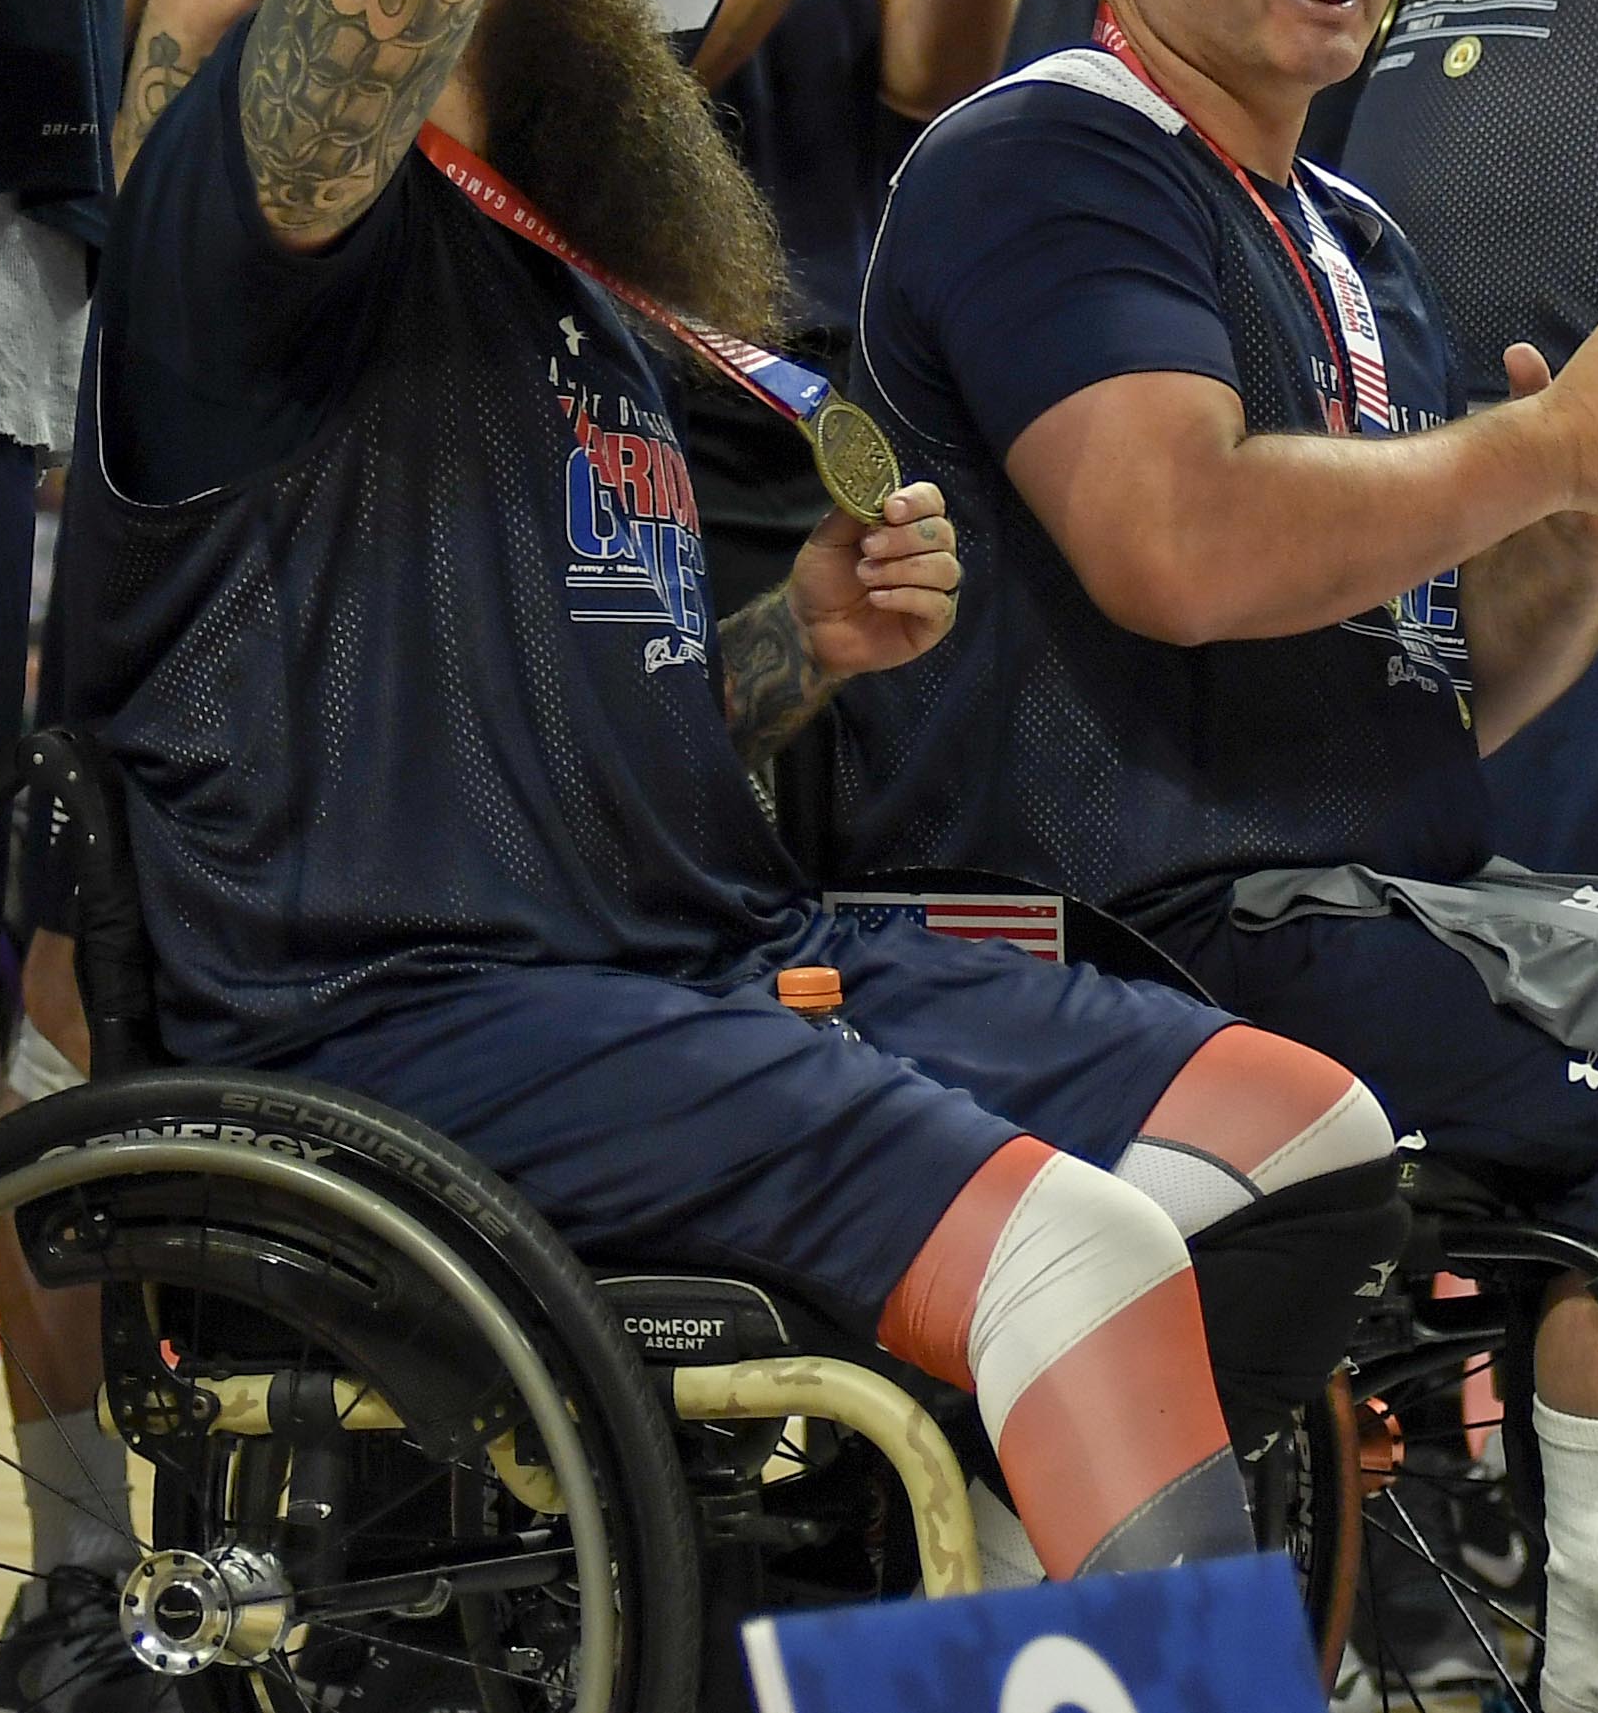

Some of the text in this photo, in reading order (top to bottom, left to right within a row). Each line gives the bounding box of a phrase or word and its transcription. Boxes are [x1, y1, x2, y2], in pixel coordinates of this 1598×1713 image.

[445, 163, 507, 210] GAMES
[568, 563, 605, 575] Army
[220, 1091, 511, 1239] SCHWALBE
[623, 1317, 725, 1337] COMFORT
[645, 1336, 706, 1350] ASCENT
